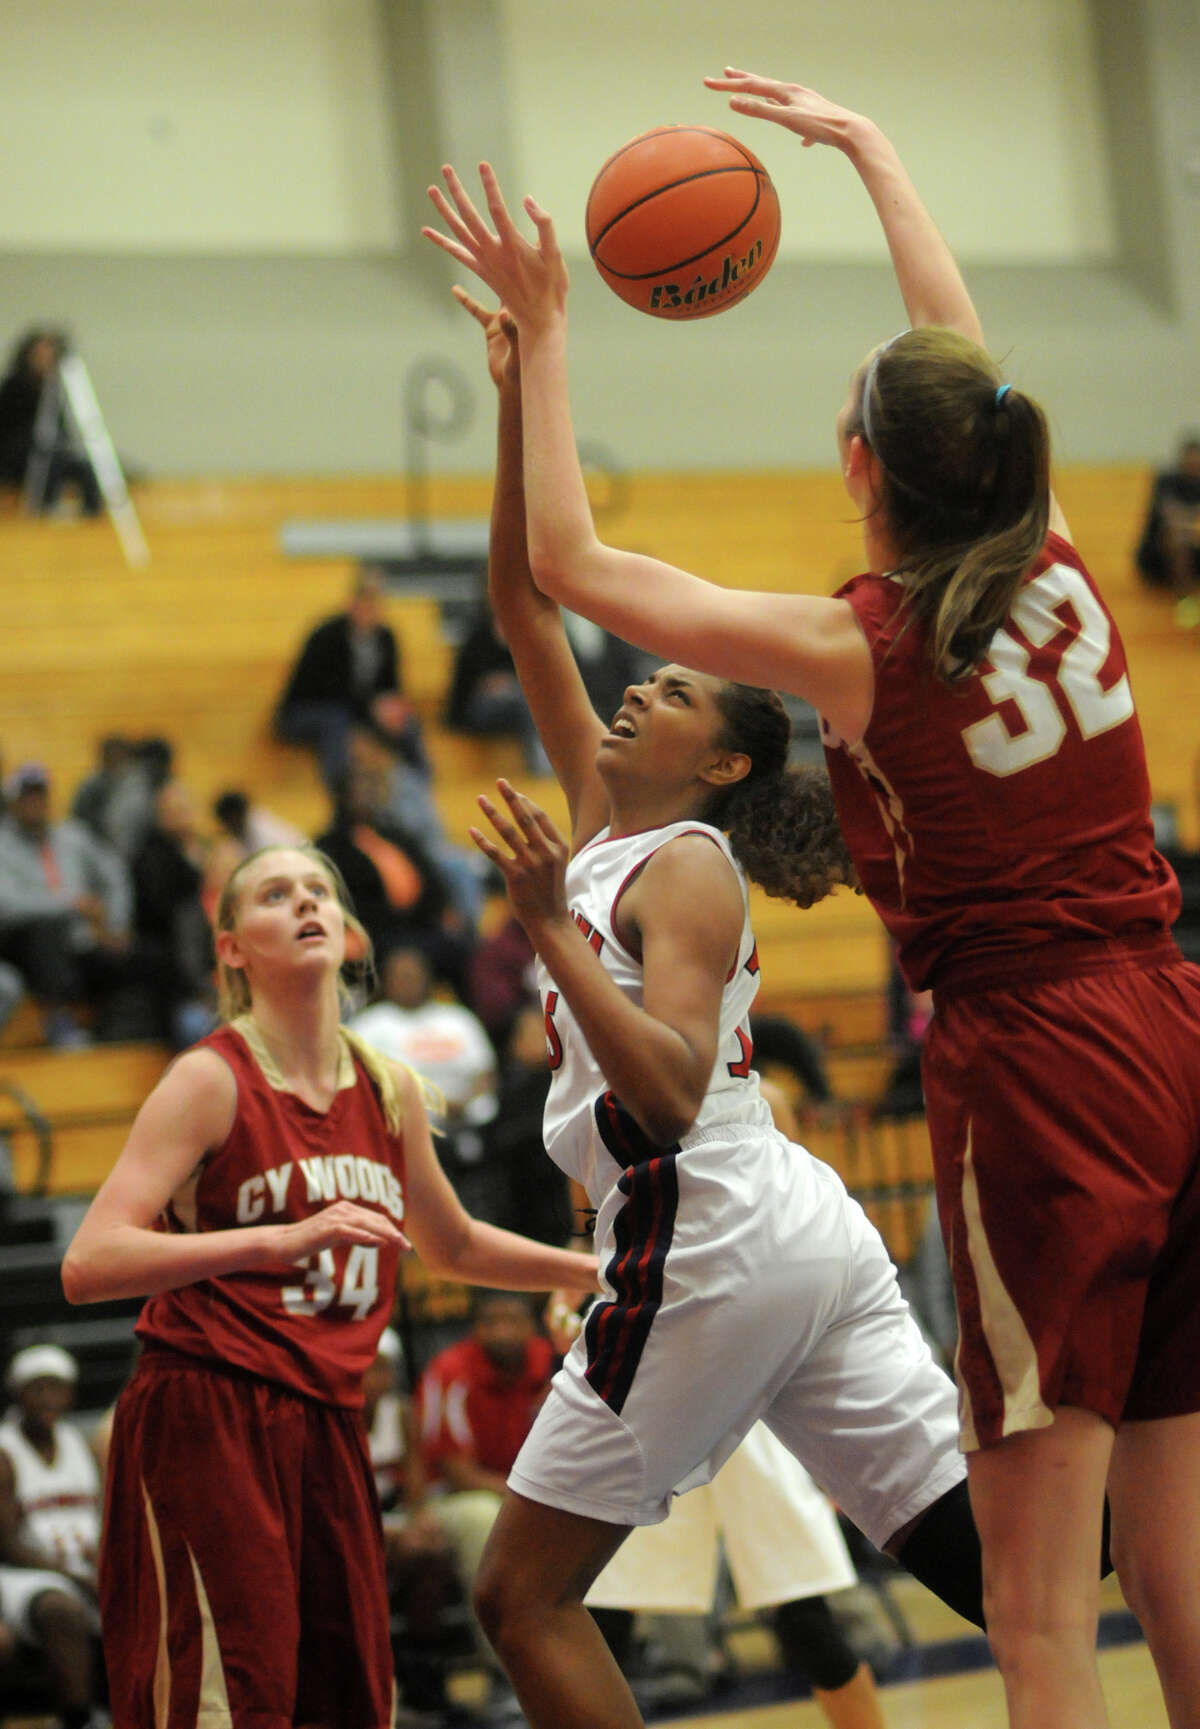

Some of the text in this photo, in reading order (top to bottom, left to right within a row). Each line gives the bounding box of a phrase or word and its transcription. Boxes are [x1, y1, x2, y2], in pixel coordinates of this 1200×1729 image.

[960, 562, 1135, 778] 32
[236, 1153, 405, 1224] CY WOODS
[281, 1244, 379, 1321] 34
